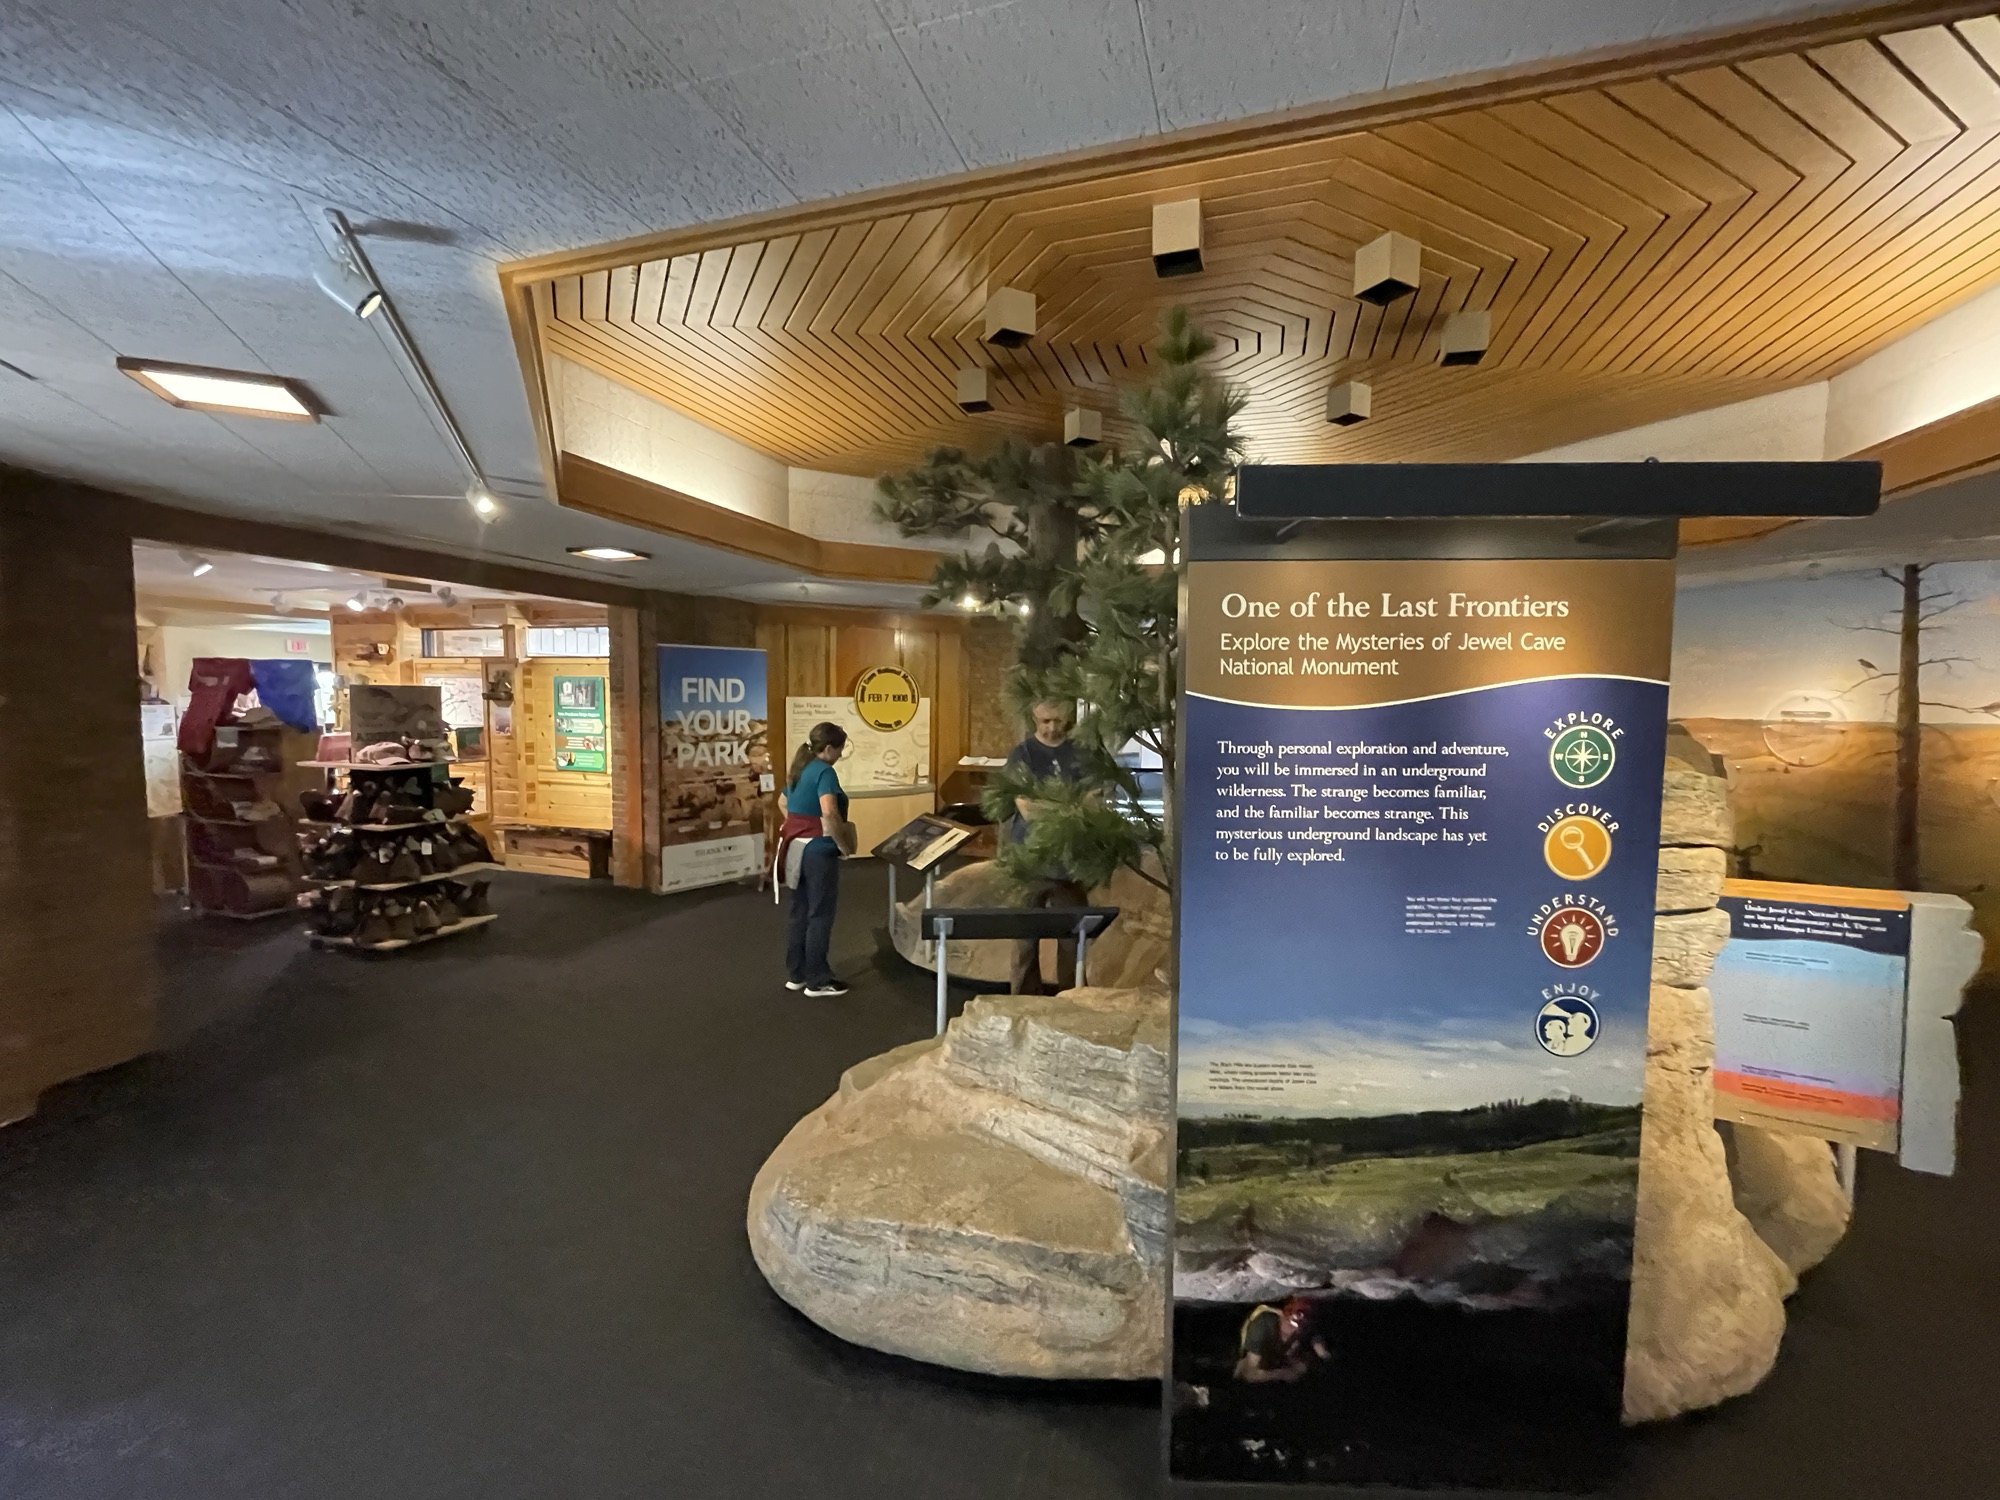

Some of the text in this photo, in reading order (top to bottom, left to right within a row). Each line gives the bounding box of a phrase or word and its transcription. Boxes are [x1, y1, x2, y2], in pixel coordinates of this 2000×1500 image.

[1221, 591, 1570, 619] One of the Last Frontiers
[1220, 631, 1566, 655] Explore the Mysteries of Jewel Cave
[1220, 657, 1399, 676] National Monument
[681, 677, 745, 703] FIND
[868, 694, 882, 702] FEB
[884, 694, 889, 702] 7
[676, 709, 751, 736] YOUR
[1544, 711, 1624, 740] EXPLORE
[676, 740, 750, 768] PARK
[1216, 740, 1510, 760] Through personal exploration and adventure,
[1215, 761, 1487, 782] you will be immersed in an underground
[1579, 775, 1585, 783] S
[1216, 782, 1487, 803] wilderness. The strange becomes familiar,
[1215, 804, 1470, 825] and the familiar becomes strange. This
[1538, 803, 1619, 833] DISCOVER
[1215, 826, 1488, 847] mysterious underground landscape has yet
[1215, 846, 1346, 867] to be fully explored.
[1527, 894, 1619, 937] UNDERSTAND
[1542, 982, 1601, 1000] ENJOY
